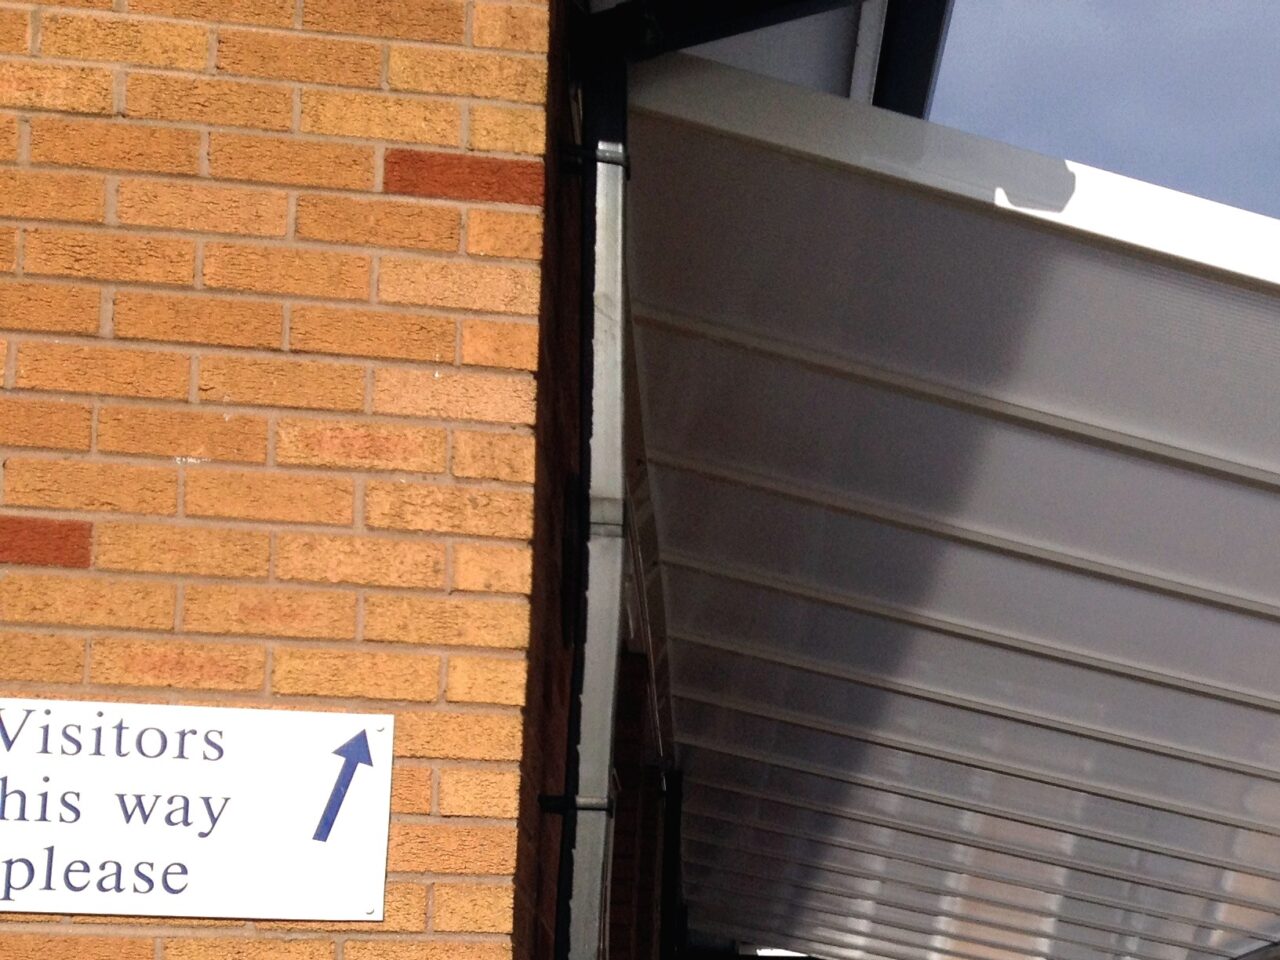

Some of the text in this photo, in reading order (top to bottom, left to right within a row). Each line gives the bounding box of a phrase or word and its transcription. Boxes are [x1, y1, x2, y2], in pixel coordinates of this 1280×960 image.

[0, 708, 225, 761] Visitors
[115, 792, 231, 838] way
[1, 845, 189, 901] please
